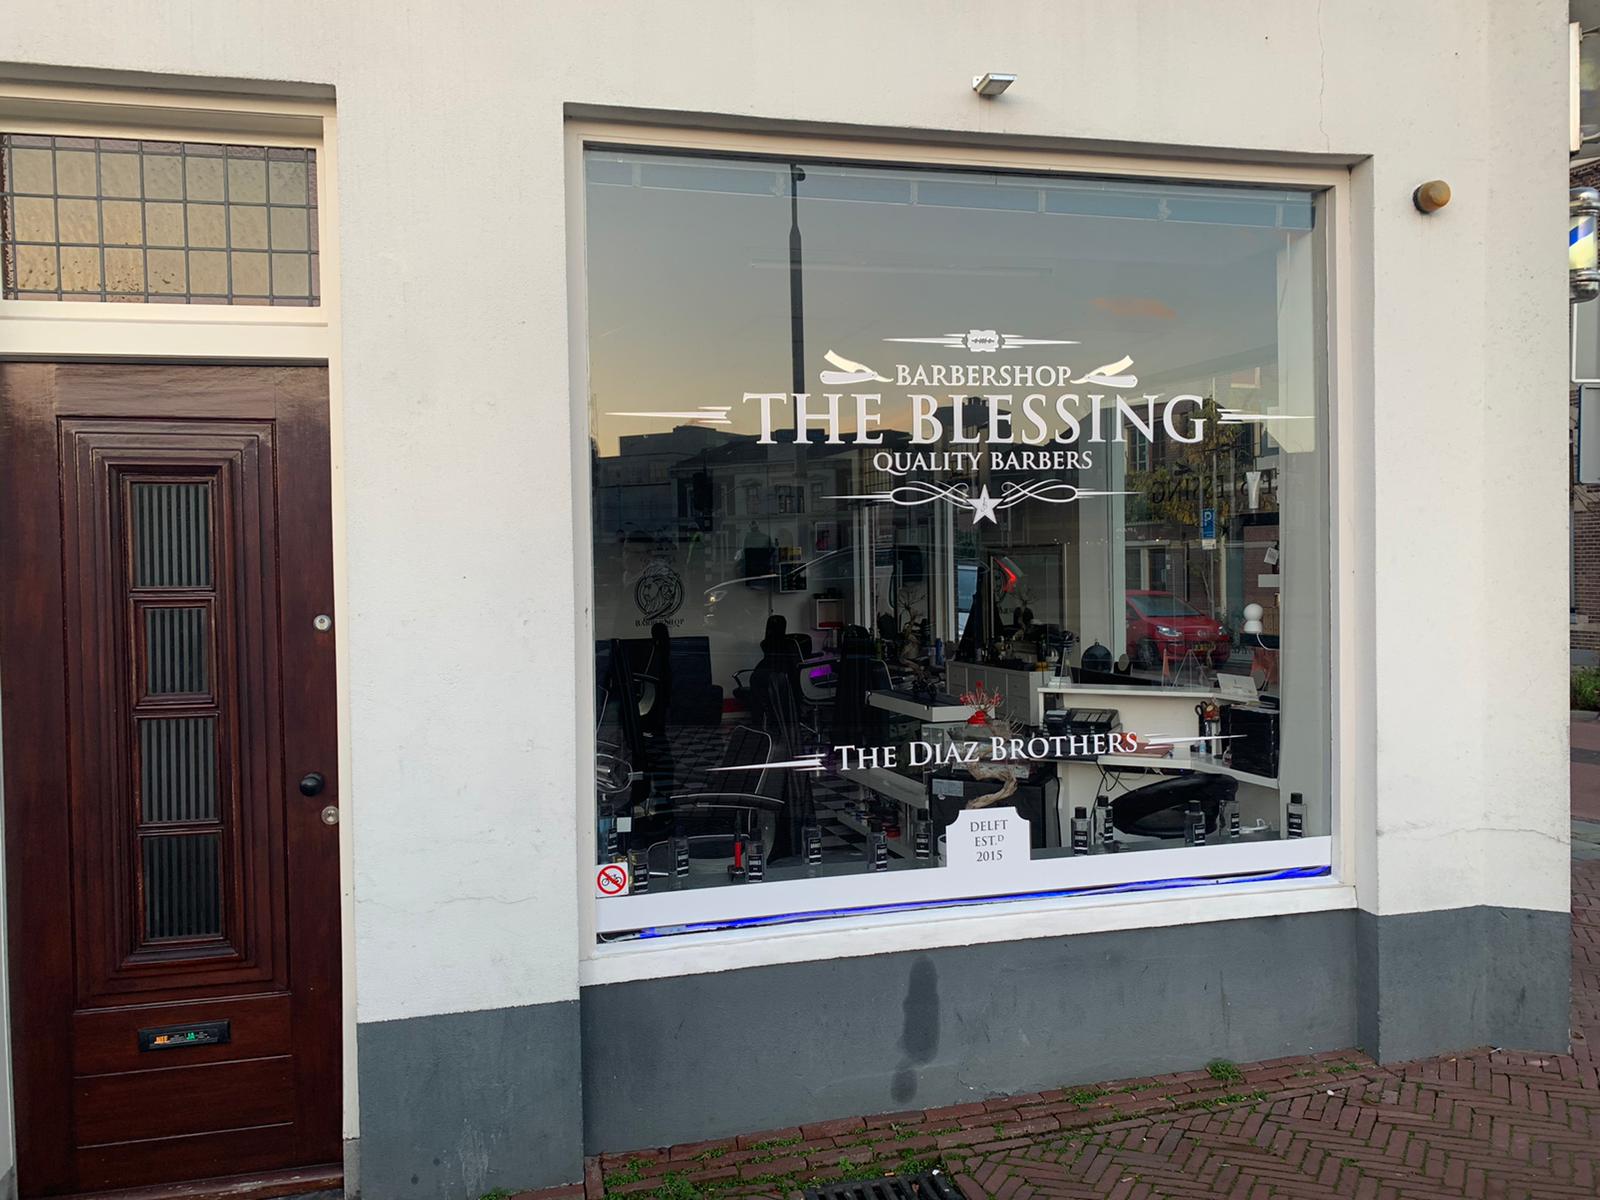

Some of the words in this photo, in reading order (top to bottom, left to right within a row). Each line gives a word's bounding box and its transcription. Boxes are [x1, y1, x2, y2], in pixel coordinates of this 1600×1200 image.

[895, 364, 1072, 387] BARBERSHOP
[742, 392, 884, 445] THE
[907, 393, 1208, 445] BLESSING
[872, 451, 984, 476] QUALITY
[990, 451, 1093, 471] BARBERS
[833, 744, 897, 771] THE
[908, 741, 980, 767] DIAZ
[990, 731, 1138, 761] BROTHERS
[970, 819, 1008, 832] DELFT
[976, 850, 1003, 862] 2015
